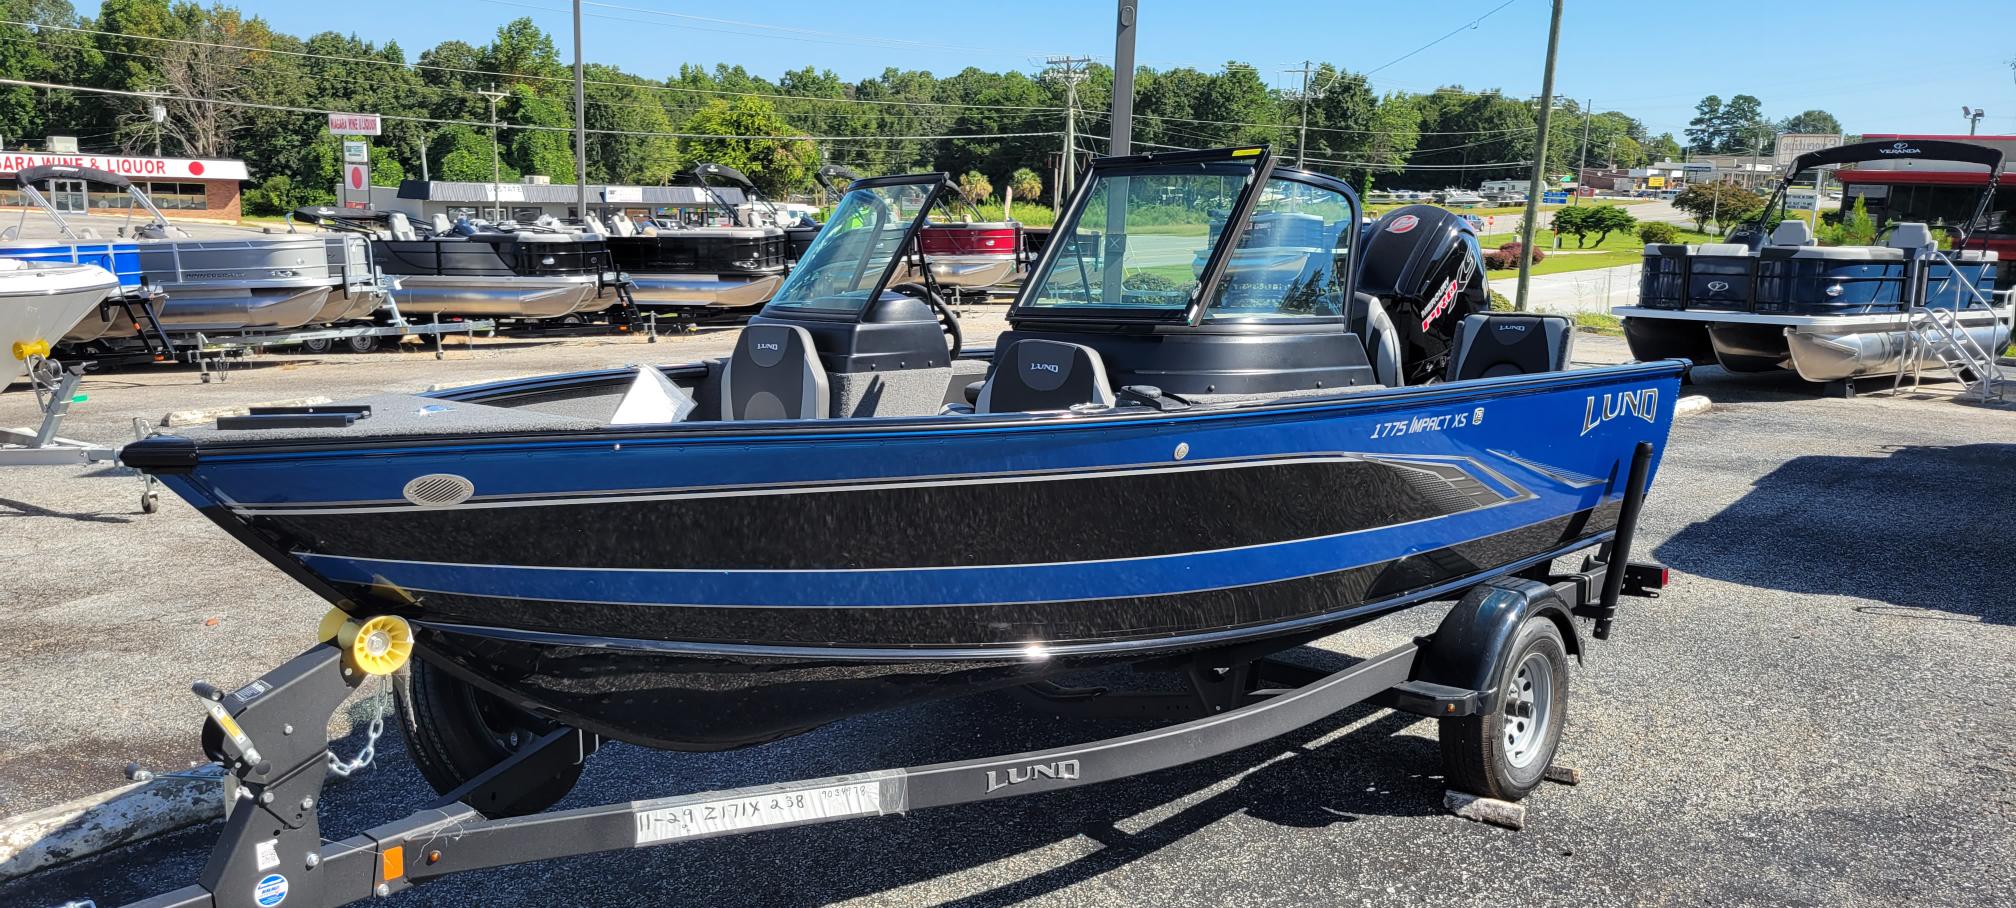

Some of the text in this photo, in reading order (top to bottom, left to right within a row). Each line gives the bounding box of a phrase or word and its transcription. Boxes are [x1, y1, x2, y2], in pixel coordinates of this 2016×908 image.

[0, 156, 166, 174] ARA WINE & LIQUOR
[1422, 280, 1457, 332] PRO
[756, 343, 778, 351] LUND
[1030, 362, 1059, 373] LUND
[1580, 388, 1659, 437] LUND
[1370, 420, 1408, 439] 1775
[1451, 412, 1469, 428] XS
[984, 759, 1080, 795] LUND
[639, 808, 694, 832] 11-29
